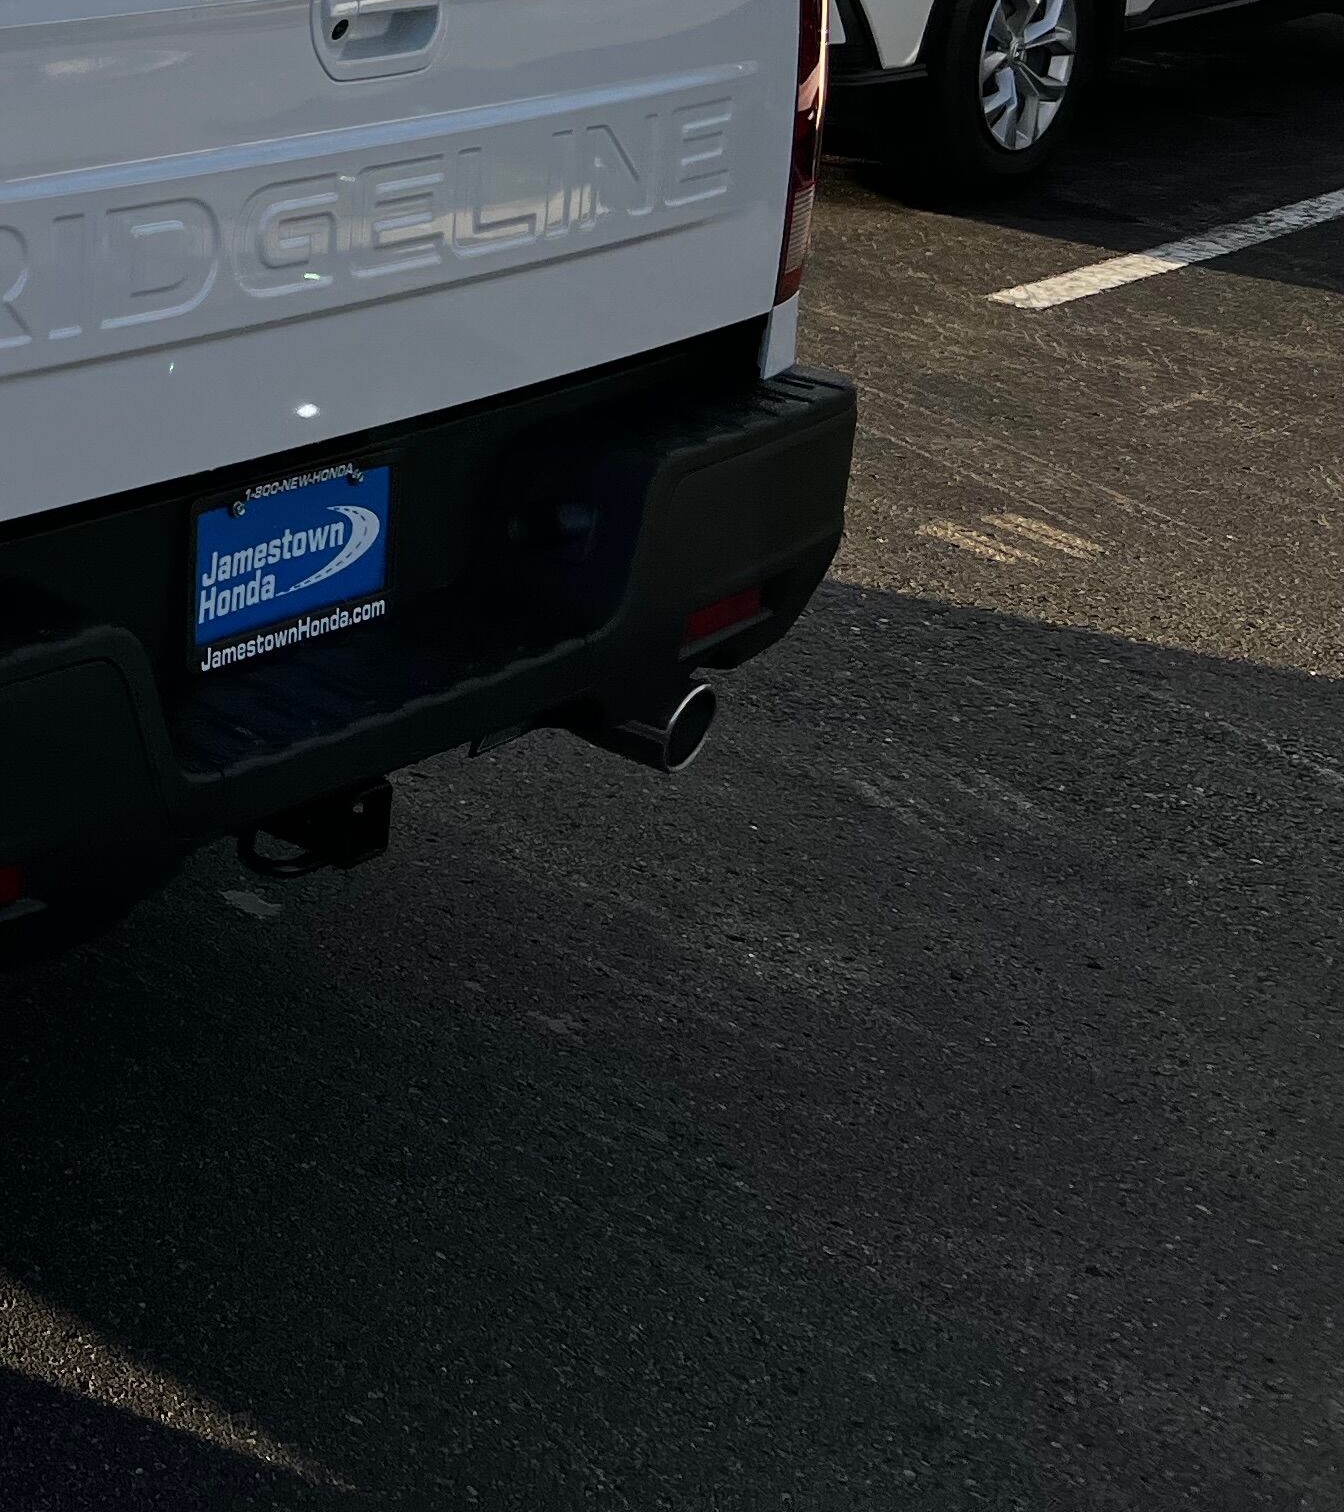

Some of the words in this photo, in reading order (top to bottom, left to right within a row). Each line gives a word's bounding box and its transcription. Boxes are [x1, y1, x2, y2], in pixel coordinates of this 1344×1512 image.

[244, 462, 354, 502] 1-800-NEW-HONDA
[201, 520, 346, 588] Jamestown
[197, 569, 276, 624] Honda
[200, 598, 386, 672] JamestownHonda.com
